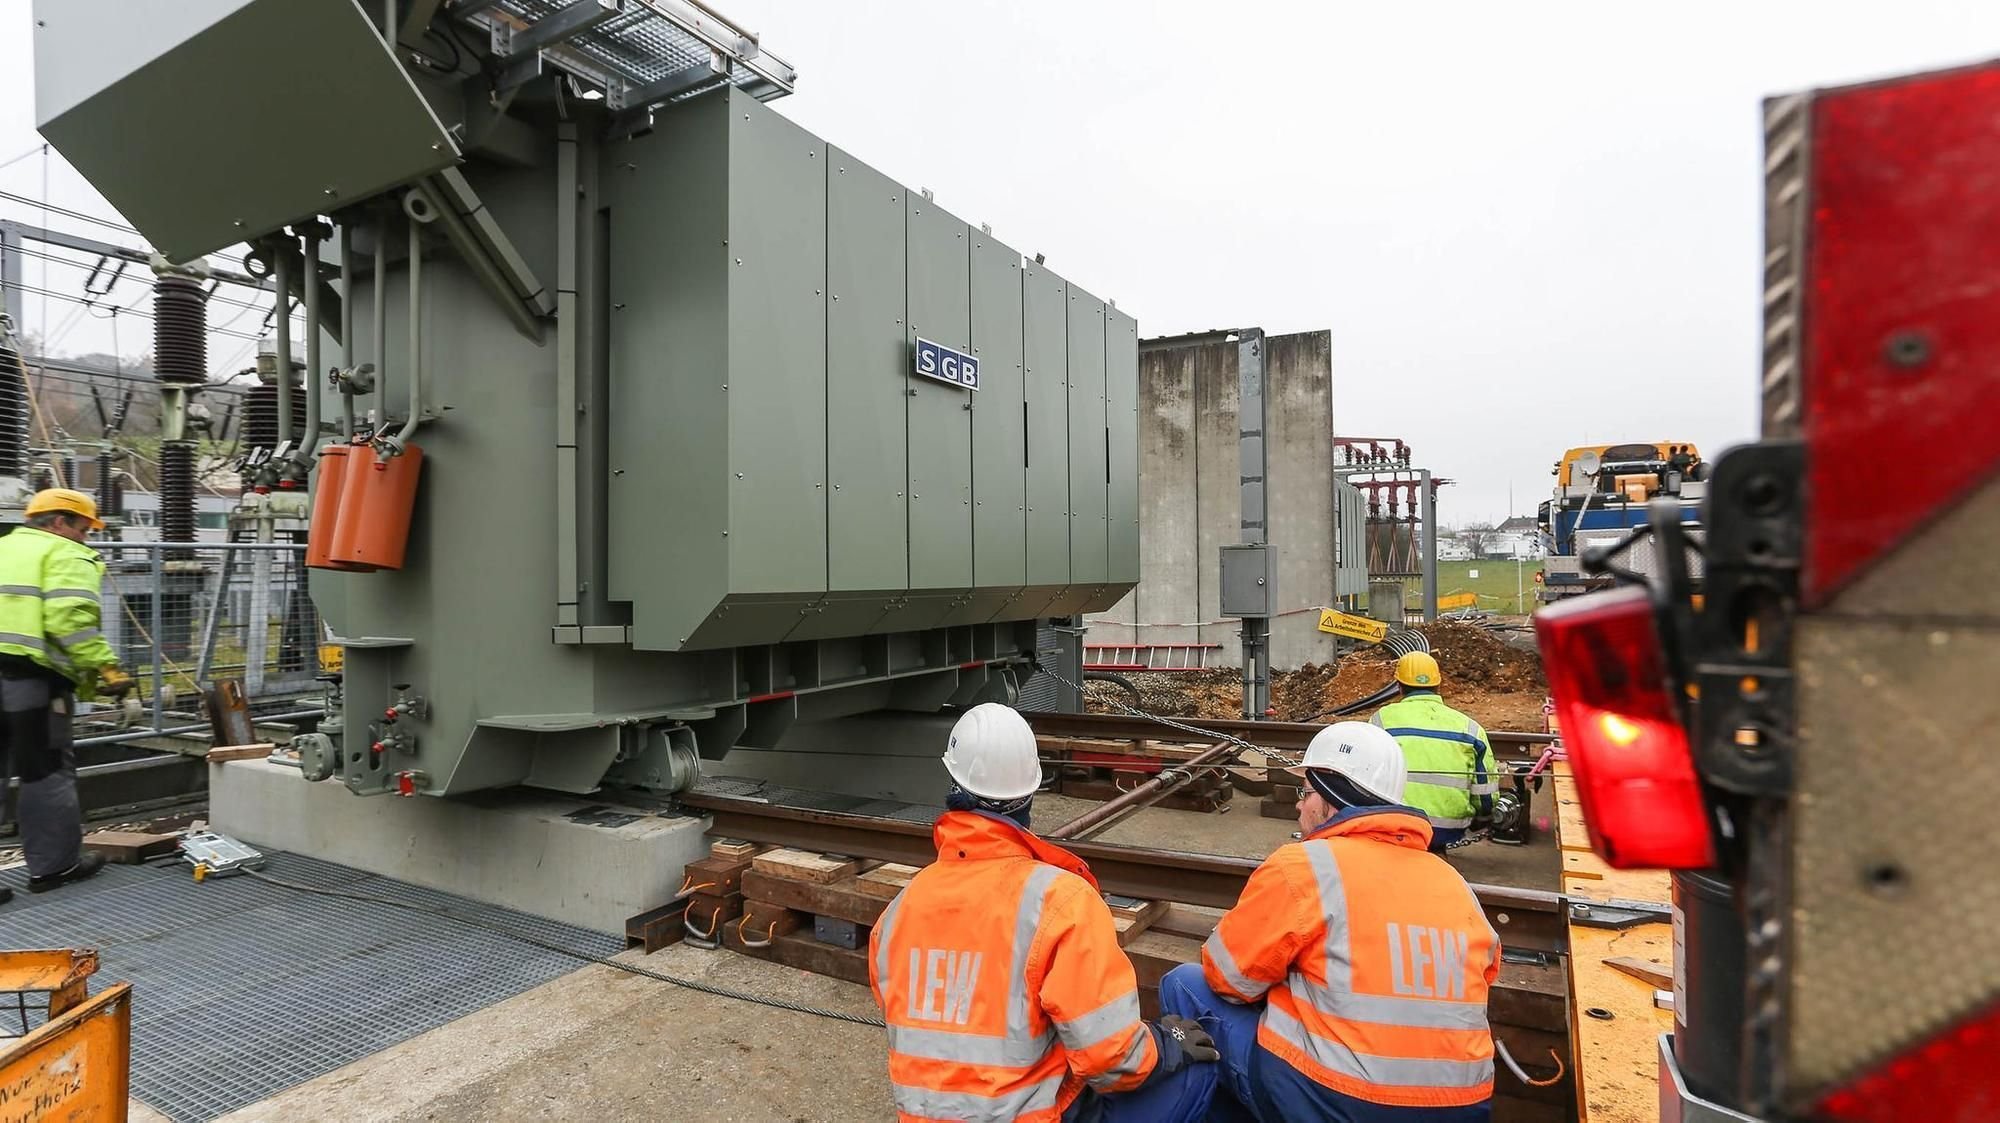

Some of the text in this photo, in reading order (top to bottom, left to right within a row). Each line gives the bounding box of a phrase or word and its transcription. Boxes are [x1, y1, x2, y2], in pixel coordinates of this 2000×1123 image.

[921, 349, 976, 386] SGB
[1339, 743, 1353, 754] LEW
[907, 947, 983, 1025] LEW
[1386, 922, 1467, 999] LEW
